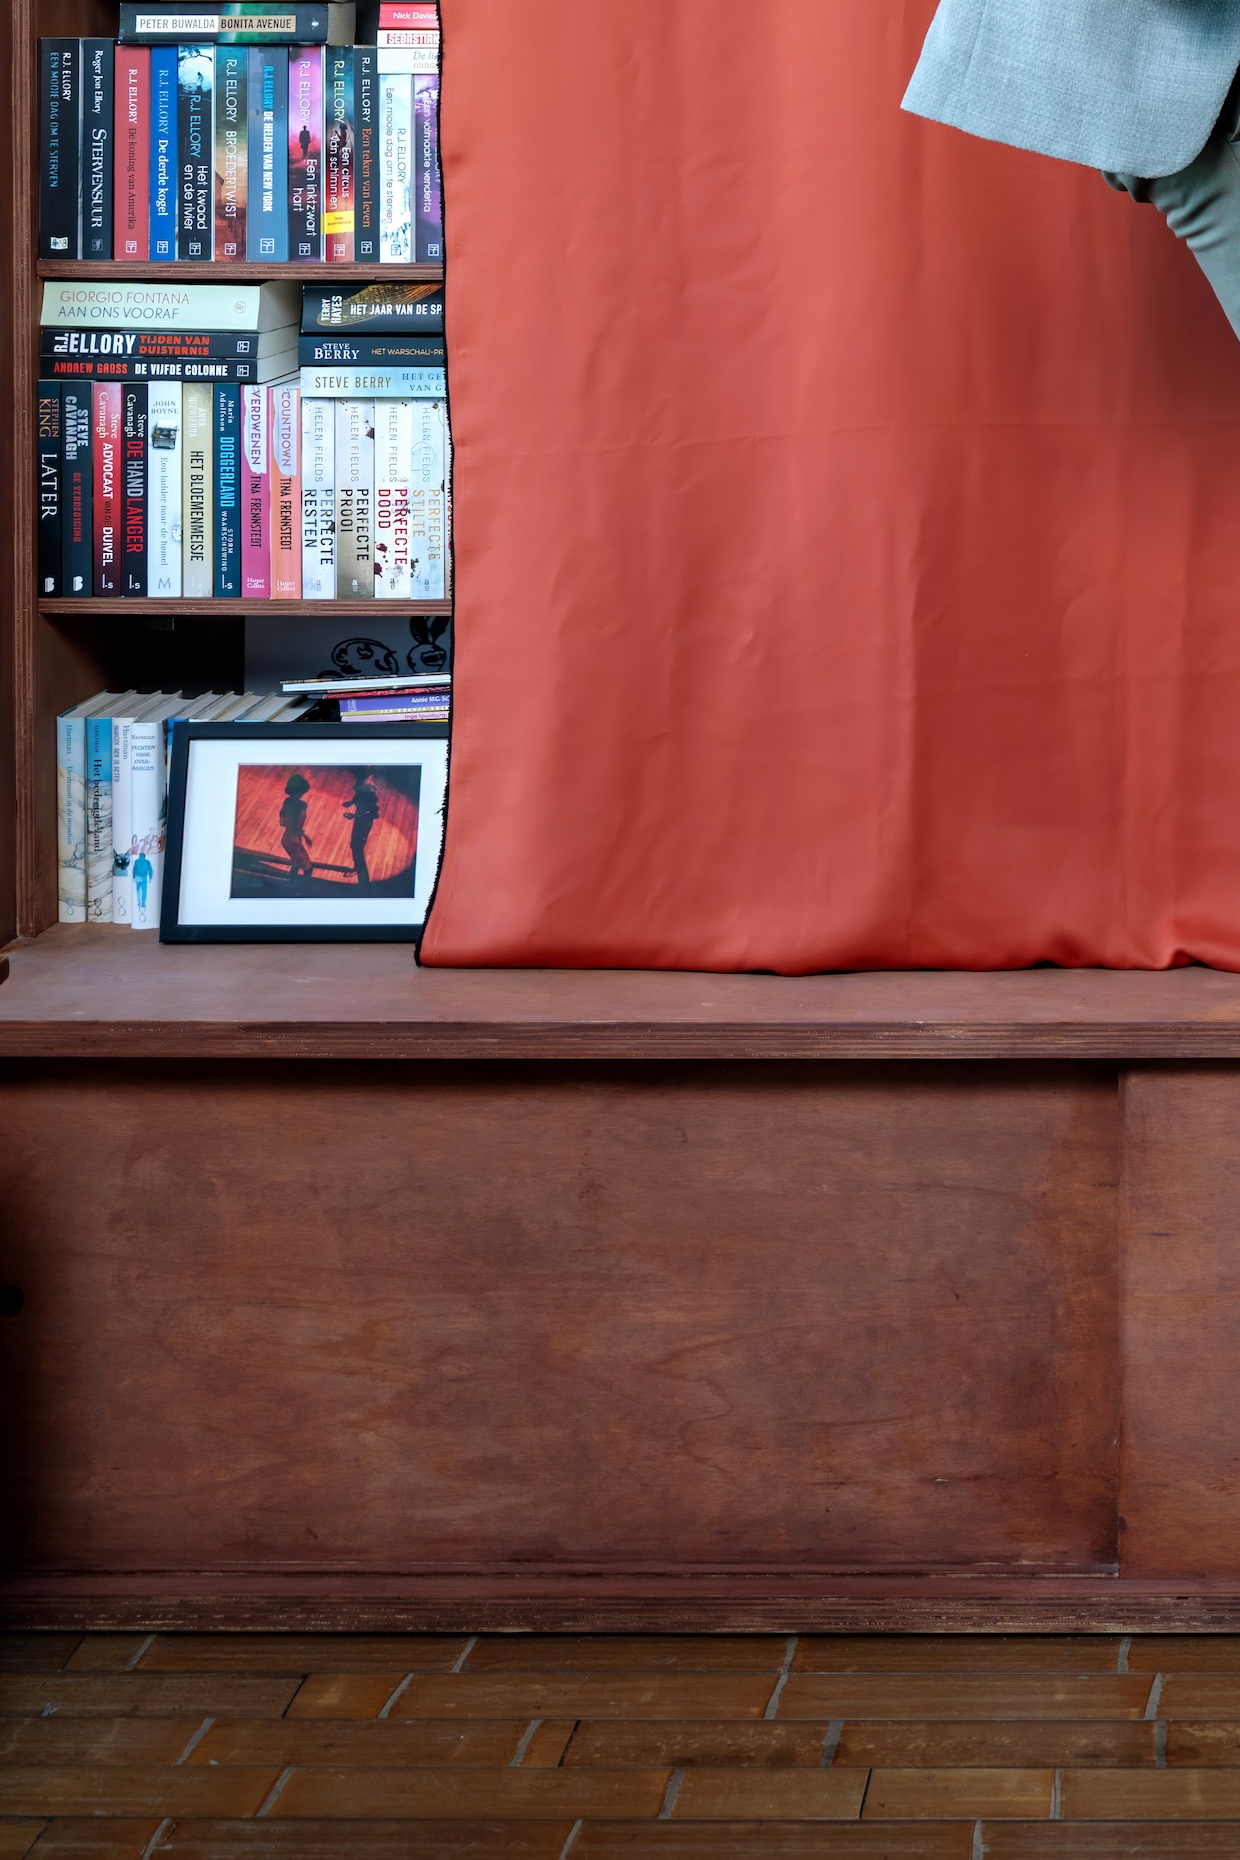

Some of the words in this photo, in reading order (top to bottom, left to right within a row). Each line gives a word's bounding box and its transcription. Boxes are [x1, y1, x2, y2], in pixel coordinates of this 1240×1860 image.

[140, 19, 168, 29] PETER
[172, 19, 215, 29] BUWALDA
[221, 19, 253, 29] BONITA
[256, 19, 291, 29] AVENUE
[158, 140, 168, 154] De
[91, 128, 107, 227] STERVENSUUR
[158, 156, 168, 185] derde
[157, 187, 168, 216] kogel
[60, 291, 123, 302] GIORGIO
[127, 292, 189, 304] FONTANA
[58, 306, 85, 317] AAN
[90, 307, 119, 318] ONS
[123, 307, 179, 319] VOORAF
[69, 335, 136, 353] ELLORY
[135, 363, 148, 374] DE
[150, 363, 182, 375] VIJFDE
[185, 363, 228, 376] COLONNE
[41, 453, 57, 520] LATER
